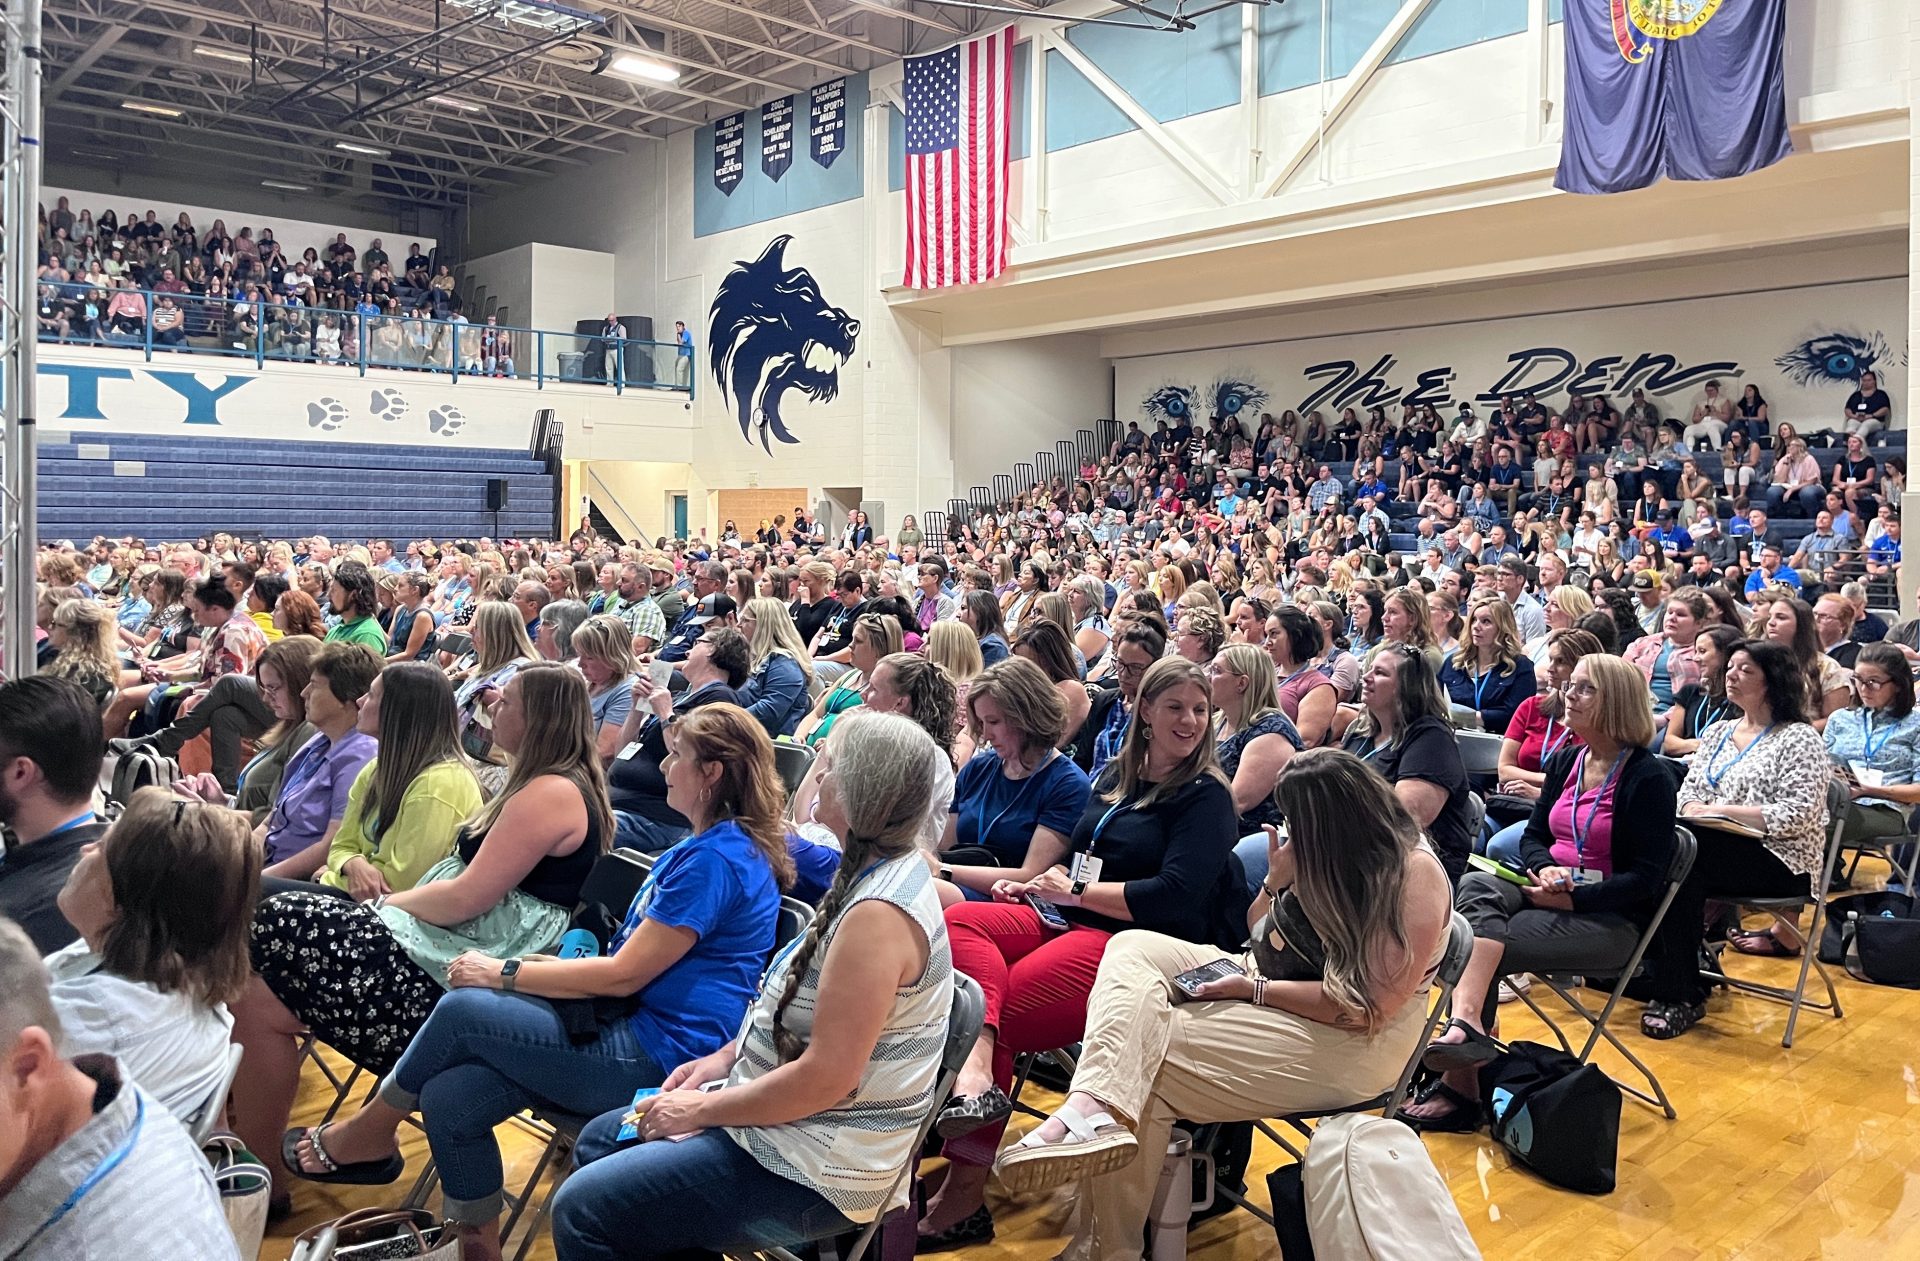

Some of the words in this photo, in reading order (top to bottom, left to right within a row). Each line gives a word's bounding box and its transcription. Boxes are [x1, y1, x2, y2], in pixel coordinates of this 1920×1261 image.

[816, 89, 841, 104] CHAMPIONS
[812, 105, 821, 117] ALL
[823, 97, 844, 113] SPORTS
[819, 110, 836, 124] AWARD
[812, 126, 824, 136] LAKE
[825, 122, 836, 132] CITY
